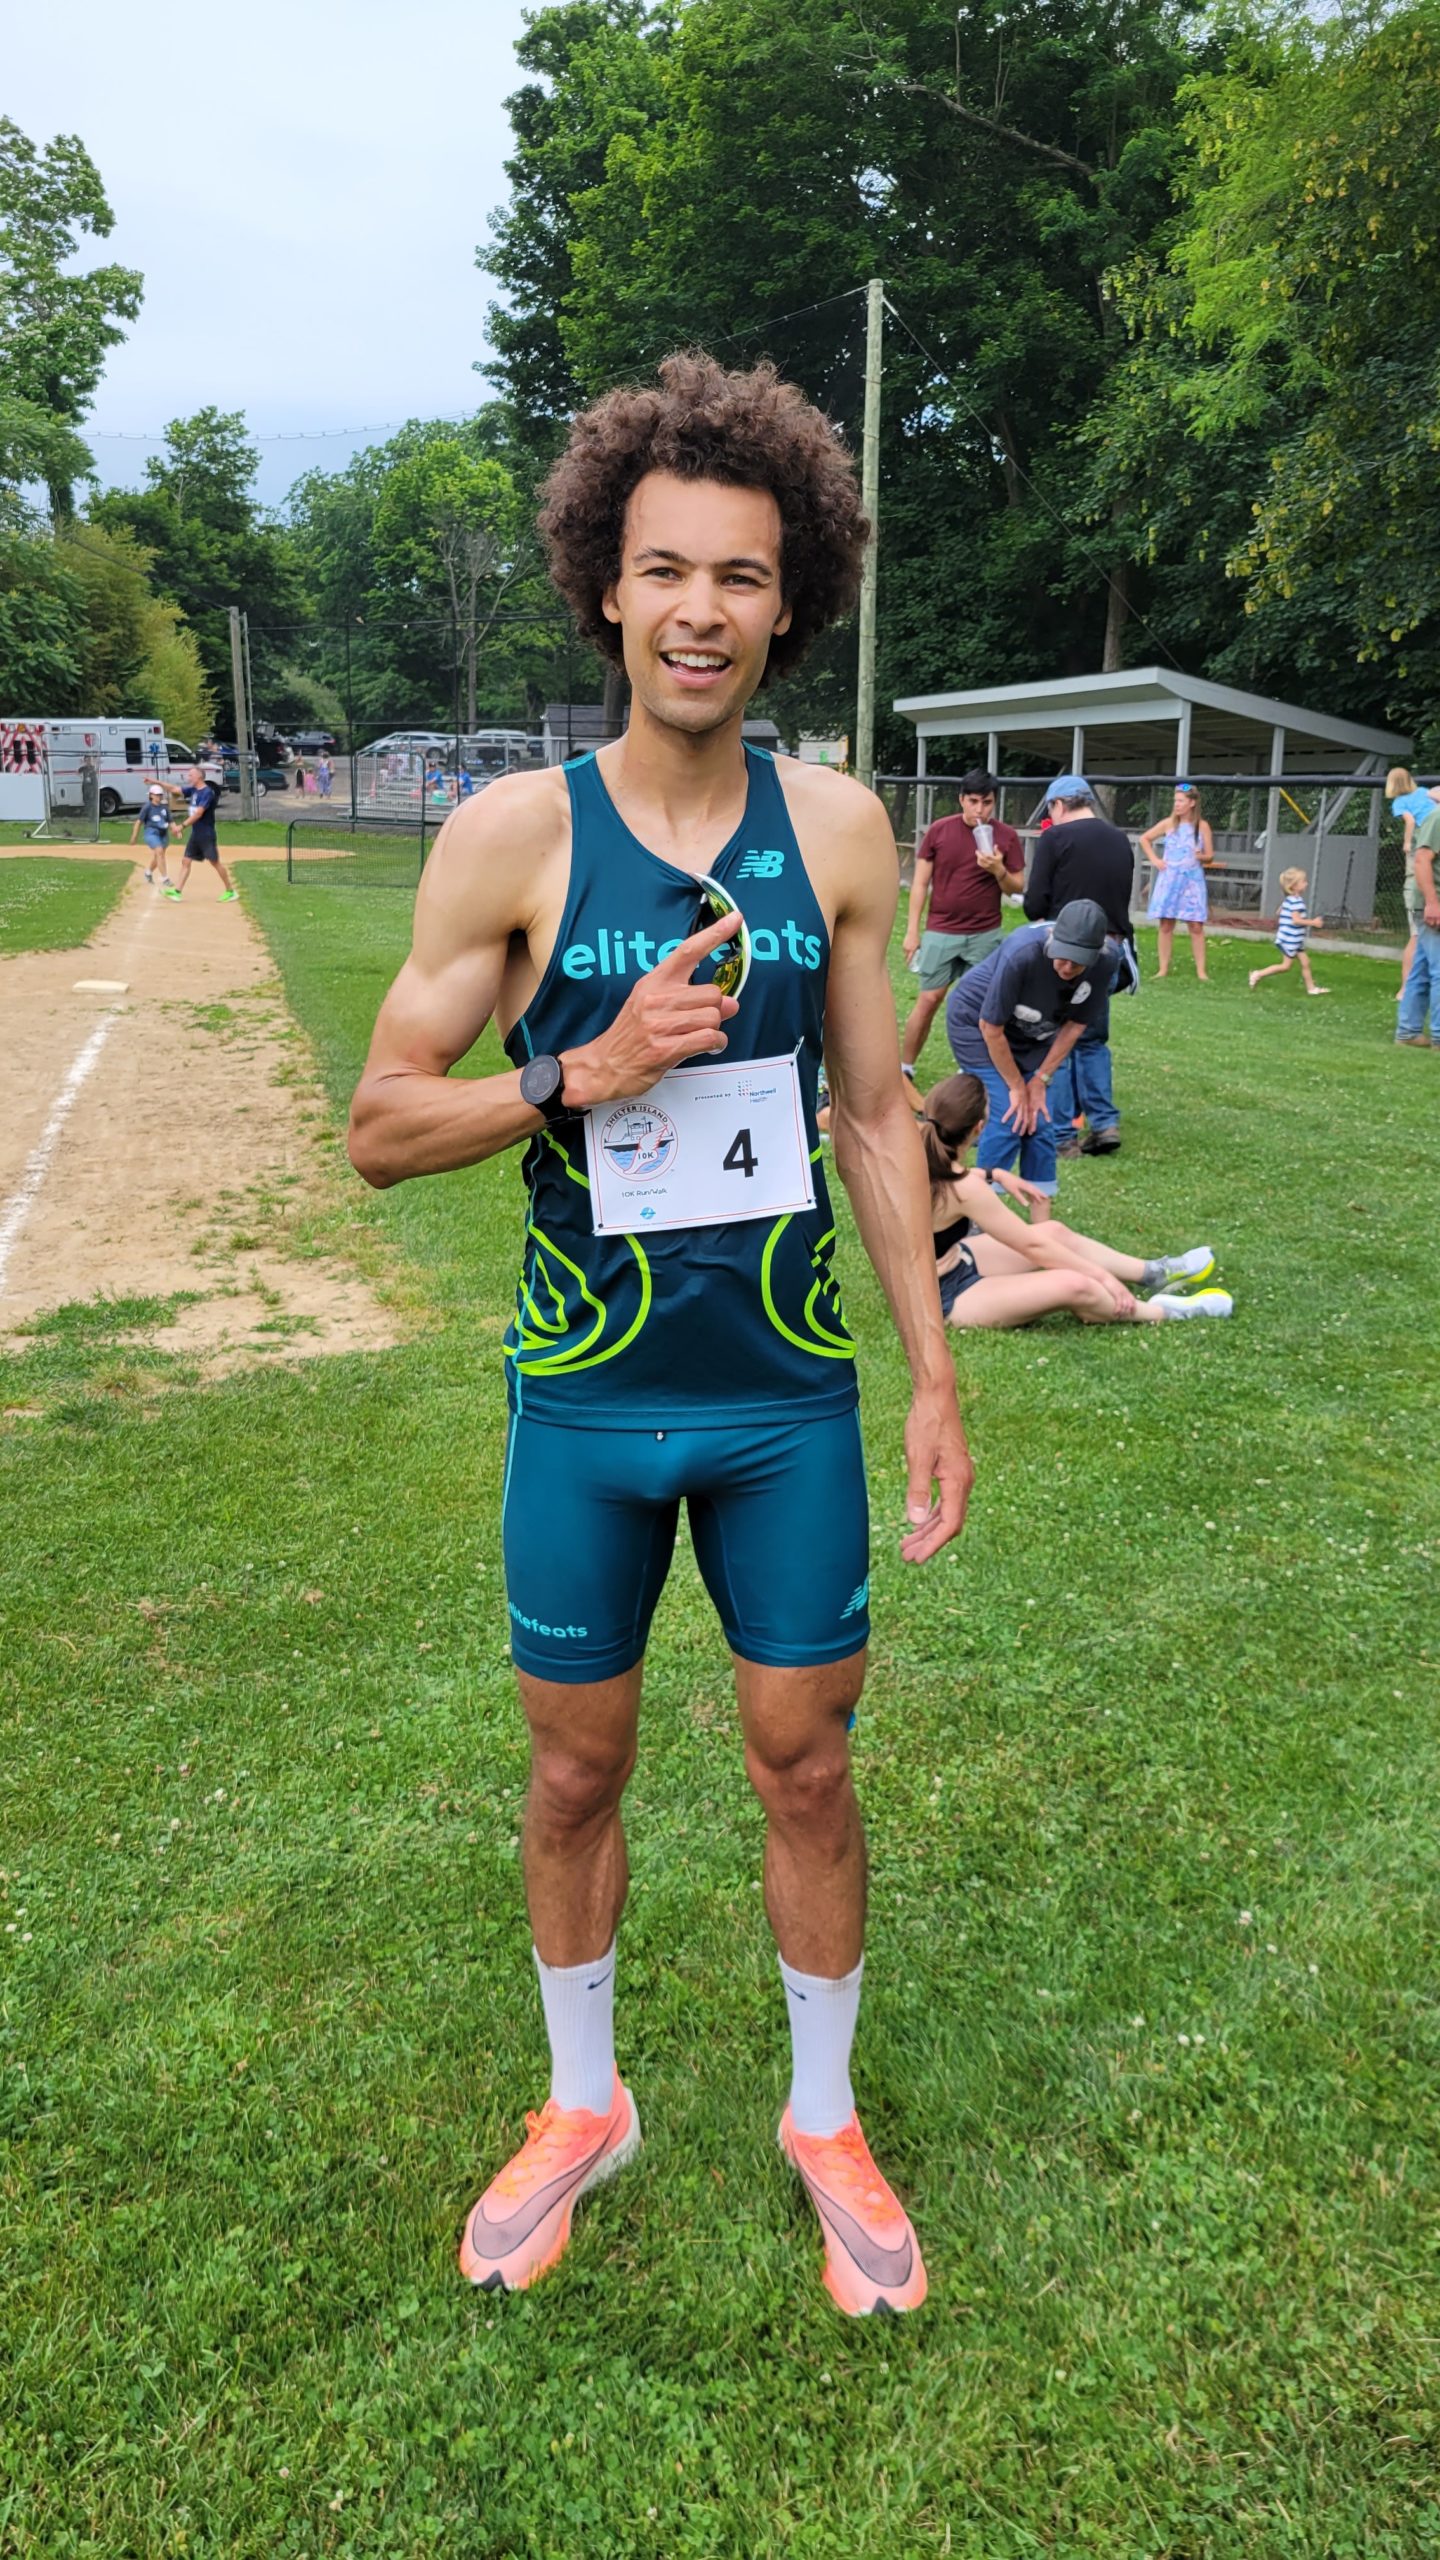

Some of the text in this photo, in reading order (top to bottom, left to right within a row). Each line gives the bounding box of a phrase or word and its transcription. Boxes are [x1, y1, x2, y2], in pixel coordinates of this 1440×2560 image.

[606, 1105, 668, 1128] SHELTER ISLAND
[638, 1152, 654, 1160] 10K
[723, 1128, 758, 1178] 4
